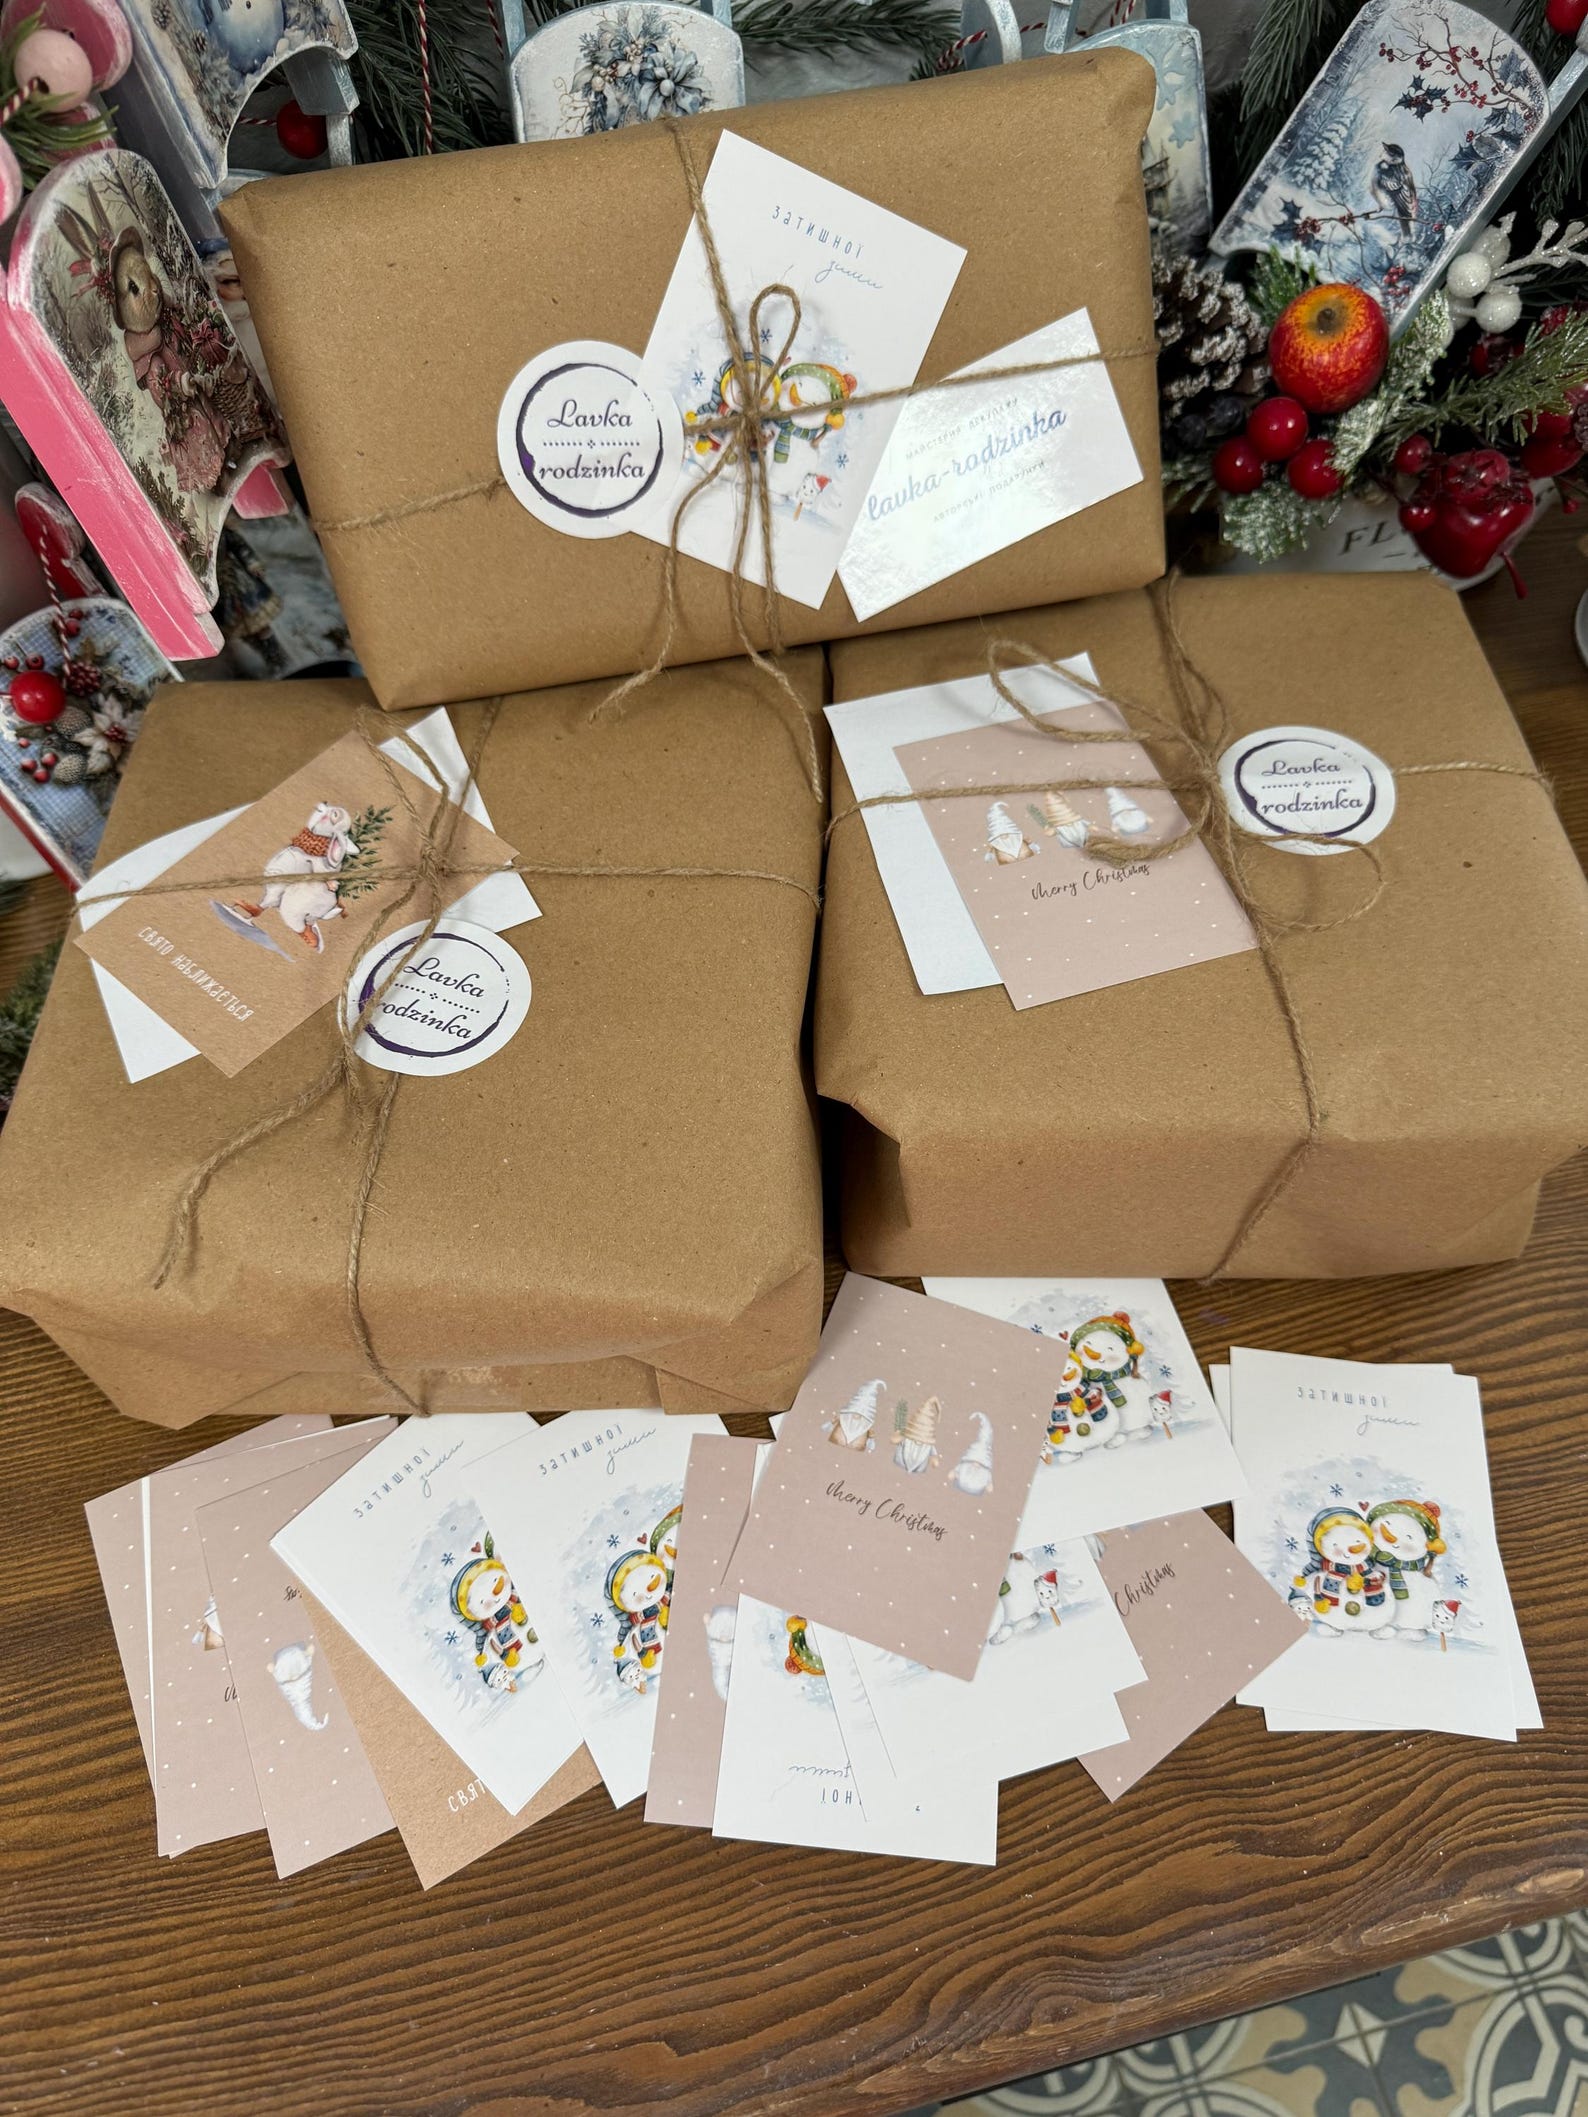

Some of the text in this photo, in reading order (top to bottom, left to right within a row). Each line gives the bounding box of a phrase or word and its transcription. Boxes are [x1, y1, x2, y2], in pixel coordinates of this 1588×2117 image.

[546, 399, 633, 428] Lavka
[538, 452, 645, 480] rodzinka
[866, 409, 1067, 522] lavka-rodzinka
[1261, 758, 1341, 777] Lavka
[1261, 788, 1363, 815] rodzinka
[1031, 863, 1151, 901] Merry Christmas
[138, 926, 175, 956] СВЯТО
[402, 957, 485, 998] Lavka
[826, 1480, 948, 1541] Merry Christmas
[1114, 1562, 1176, 1617] Christmas
[448, 1778, 485, 1812] СВЯТ
